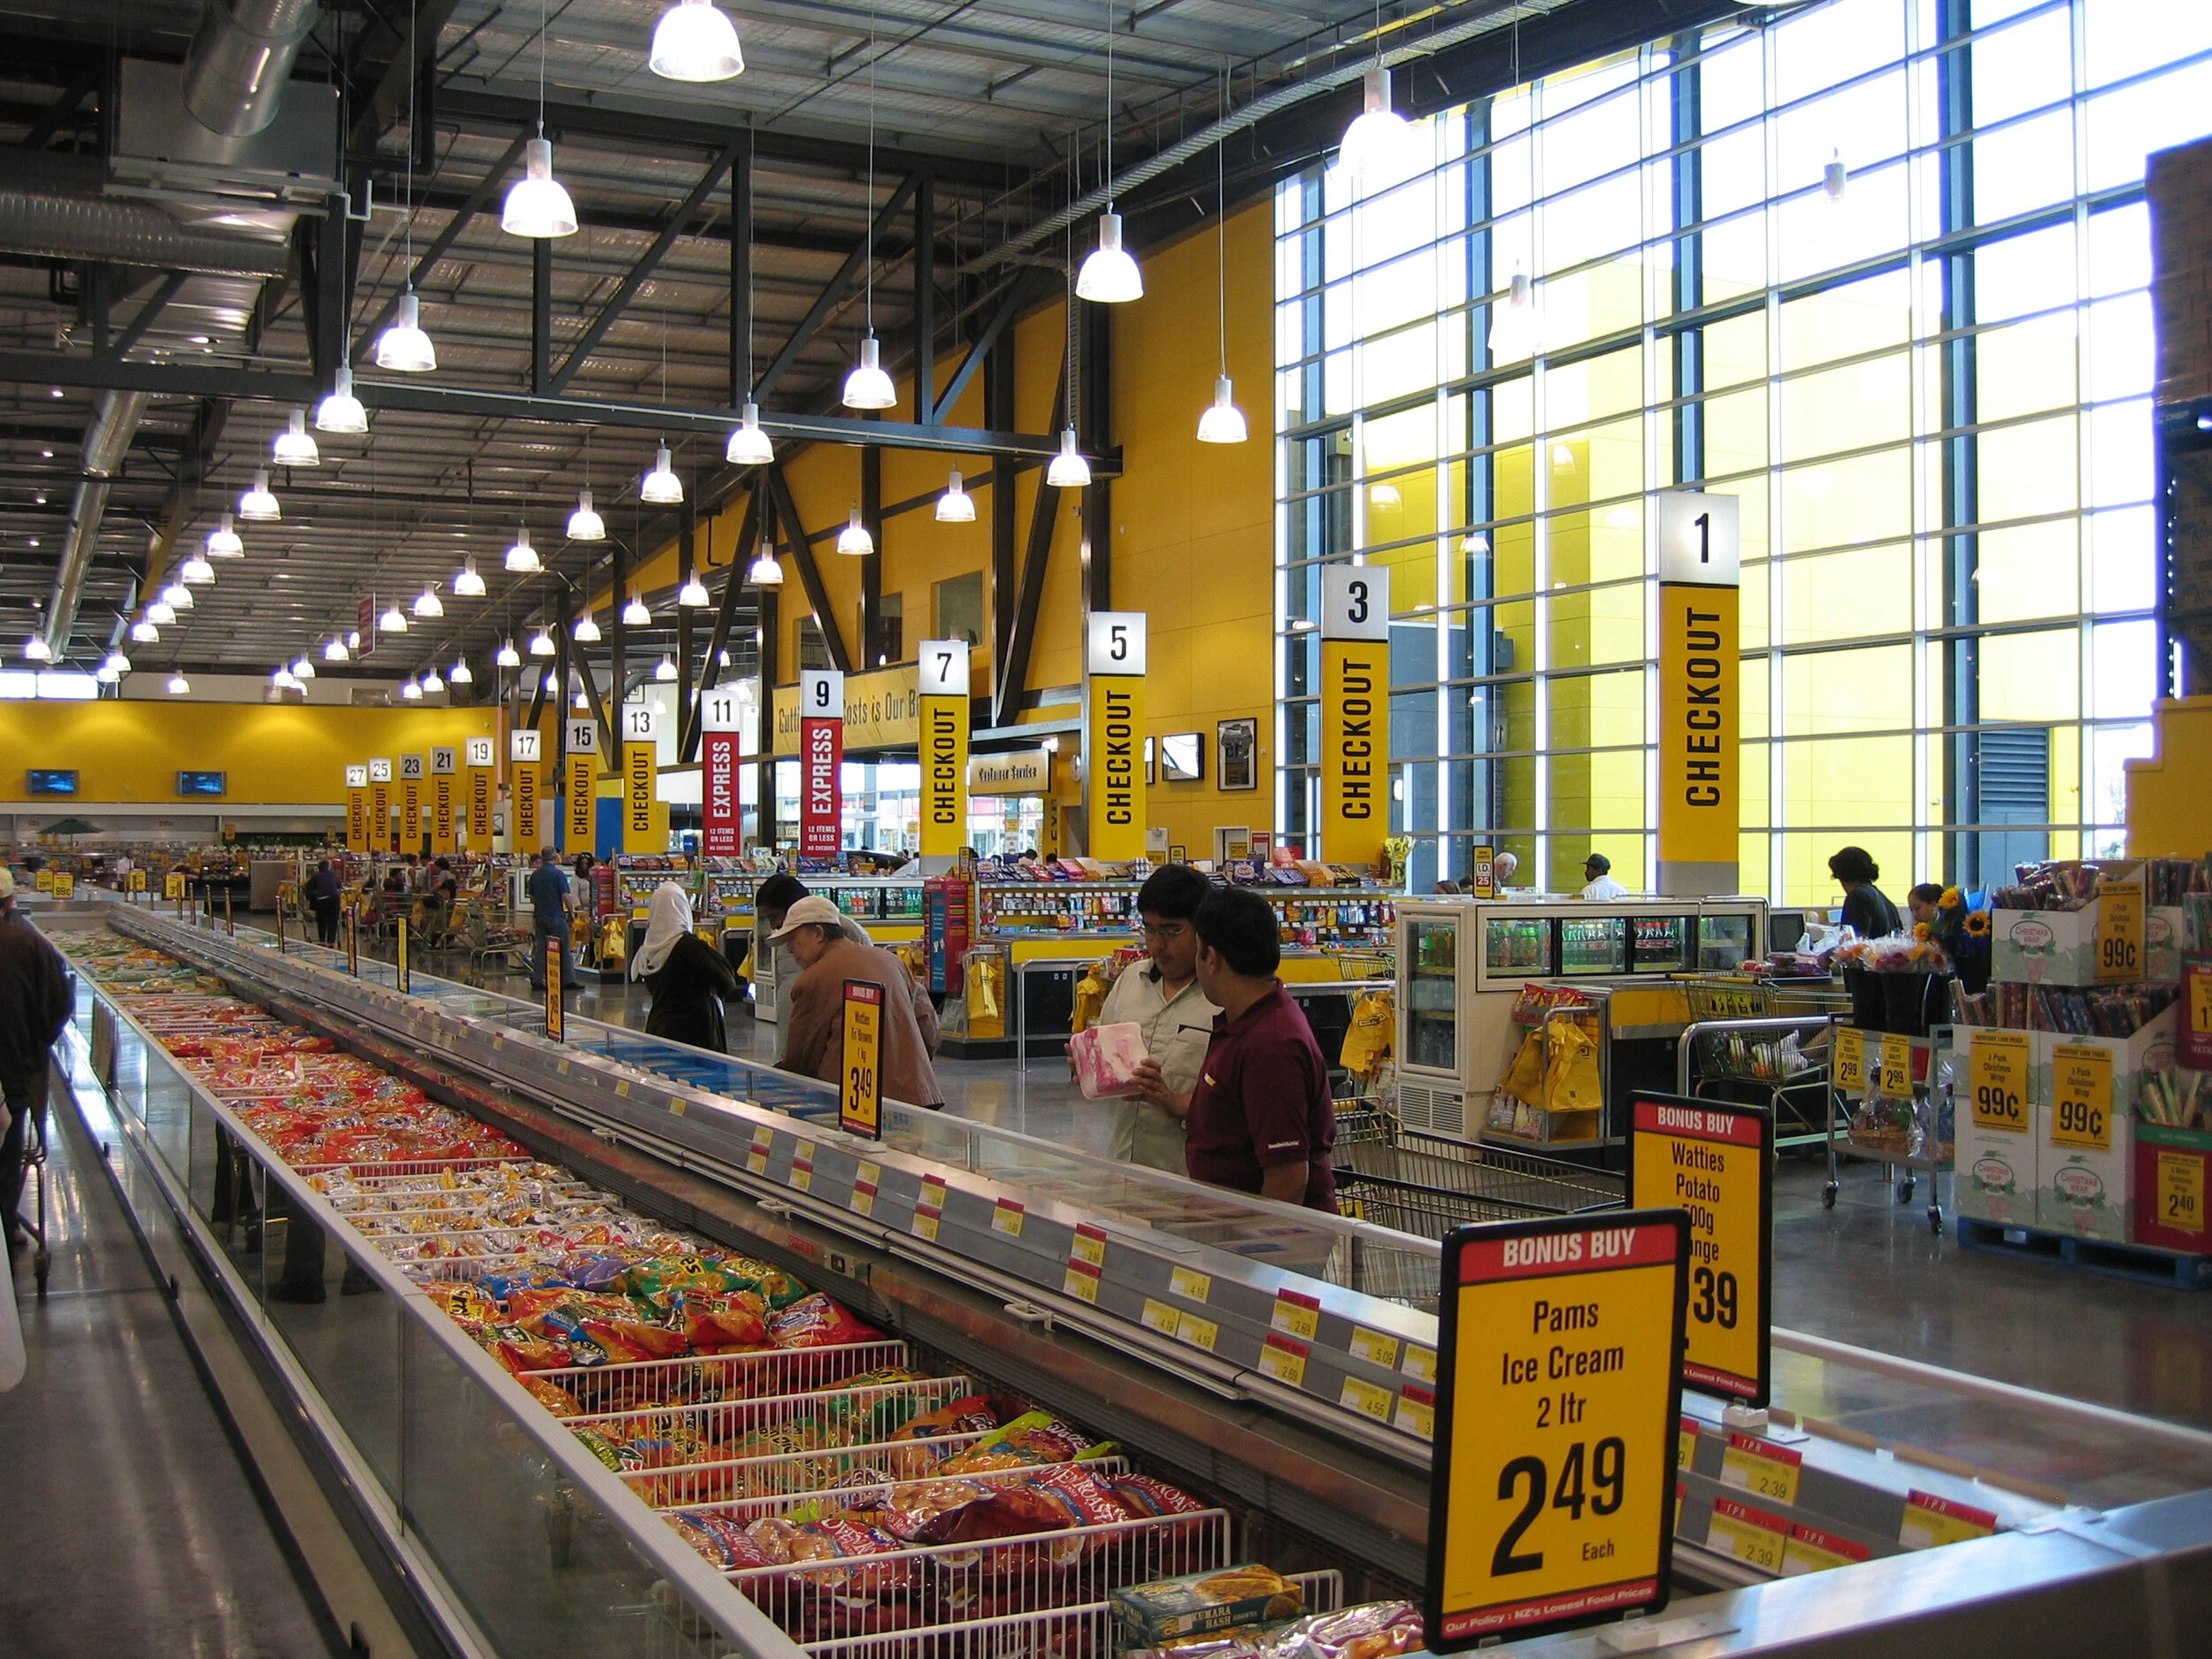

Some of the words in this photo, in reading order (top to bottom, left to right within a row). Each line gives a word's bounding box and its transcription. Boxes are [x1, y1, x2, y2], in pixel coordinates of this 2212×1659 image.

[1694, 512, 1709, 564] 1
[1348, 580, 1369, 624] 3
[1110, 625, 1128, 661] 5
[936, 653, 953, 682] 7
[816, 680, 830, 707] 9
[1686, 607, 1721, 808] CHECKOUT
[631, 711, 650, 733] 13
[712, 699, 732, 723] 11
[779, 706, 801, 734] Cutti
[872, 694, 881, 723] is
[886, 691, 904, 721] Our
[473, 742, 488, 760] 19
[517, 736, 535, 755] 17
[573, 726, 592, 747] 15
[1341, 658, 1371, 820] CHECKOUT
[373, 763, 388, 778] 25
[404, 758, 420, 774] 23
[436, 753, 451, 769] 21
[811, 727, 833, 815] EXPRESS
[933, 708, 956, 825] CHECKOUT
[1106, 690, 1132, 825] CHECKOUT
[349, 769, 364, 783] 27
[633, 750, 649, 832] CHECKOUT
[712, 741, 732, 819] EXPRESS
[375, 787, 386, 839] CHECKOUT
[406, 784, 418, 840] CHECKOUT
[437, 780, 449, 839] CHECKOUT
[474, 772, 487, 836] CHECKOUT
[520, 769, 534, 837] CHECKOUT
[572, 762, 588, 835] CHECKOUT
[352, 792, 362, 841] CHECKOUT
[1477, 876, 1490, 886] 25
[2103, 938, 2136, 969] 99¢
[861, 1048, 866, 1063] kg
[1983, 1063, 2011, 1073] Christmas
[1990, 1073, 2005, 1083] Wrap
[2077, 1067, 2091, 1077] Pack
[1978, 1086, 2019, 1122] 99¢
[1657, 1106, 1702, 1133] BONUS
[1707, 1114, 1734, 1135] BUY
[2059, 1101, 2102, 1139] 99¢
[1671, 1141, 1724, 1172] Watties
[1676, 1173, 1720, 1203] Potato
[2060, 1172, 2098, 1186] CHRISTMAS
[1683, 1203, 1714, 1235] 00g
[1502, 1231, 1583, 1268] BONUS
[1591, 1227, 1636, 1258] BUY
[1189, 1284, 1205, 1299] 4.19
[1686, 1266, 1738, 1330] 39
[1533, 1300, 1599, 1334] Pams
[1196, 1333, 1212, 1348] 4.19
[1375, 1348, 1394, 1365] 5.09
[1502, 1352, 1538, 1386] Ice
[1548, 1345, 1624, 1381] Cream
[1366, 1400, 1384, 1417] 4.55
[1537, 1397, 1550, 1429] 2
[1560, 1391, 1586, 1425] ltr
[1077, 1479, 1116, 1523] ROAST
[1758, 1477, 1787, 1499] 2.39
[1582, 1539, 1615, 1563] Each
[1745, 1545, 1774, 1567] 2.39
[1192, 1606, 1231, 1623] KUMARA
[1205, 1616, 1232, 1630] HASH
[1446, 1622, 1467, 1633] Our
[1469, 1612, 1505, 1630] Policy
[1515, 1606, 1541, 1622] NZ's
[1544, 1598, 1585, 1616] Lowest
[1586, 1593, 1616, 1607] Food
[1617, 1586, 1653, 1600] Prices
